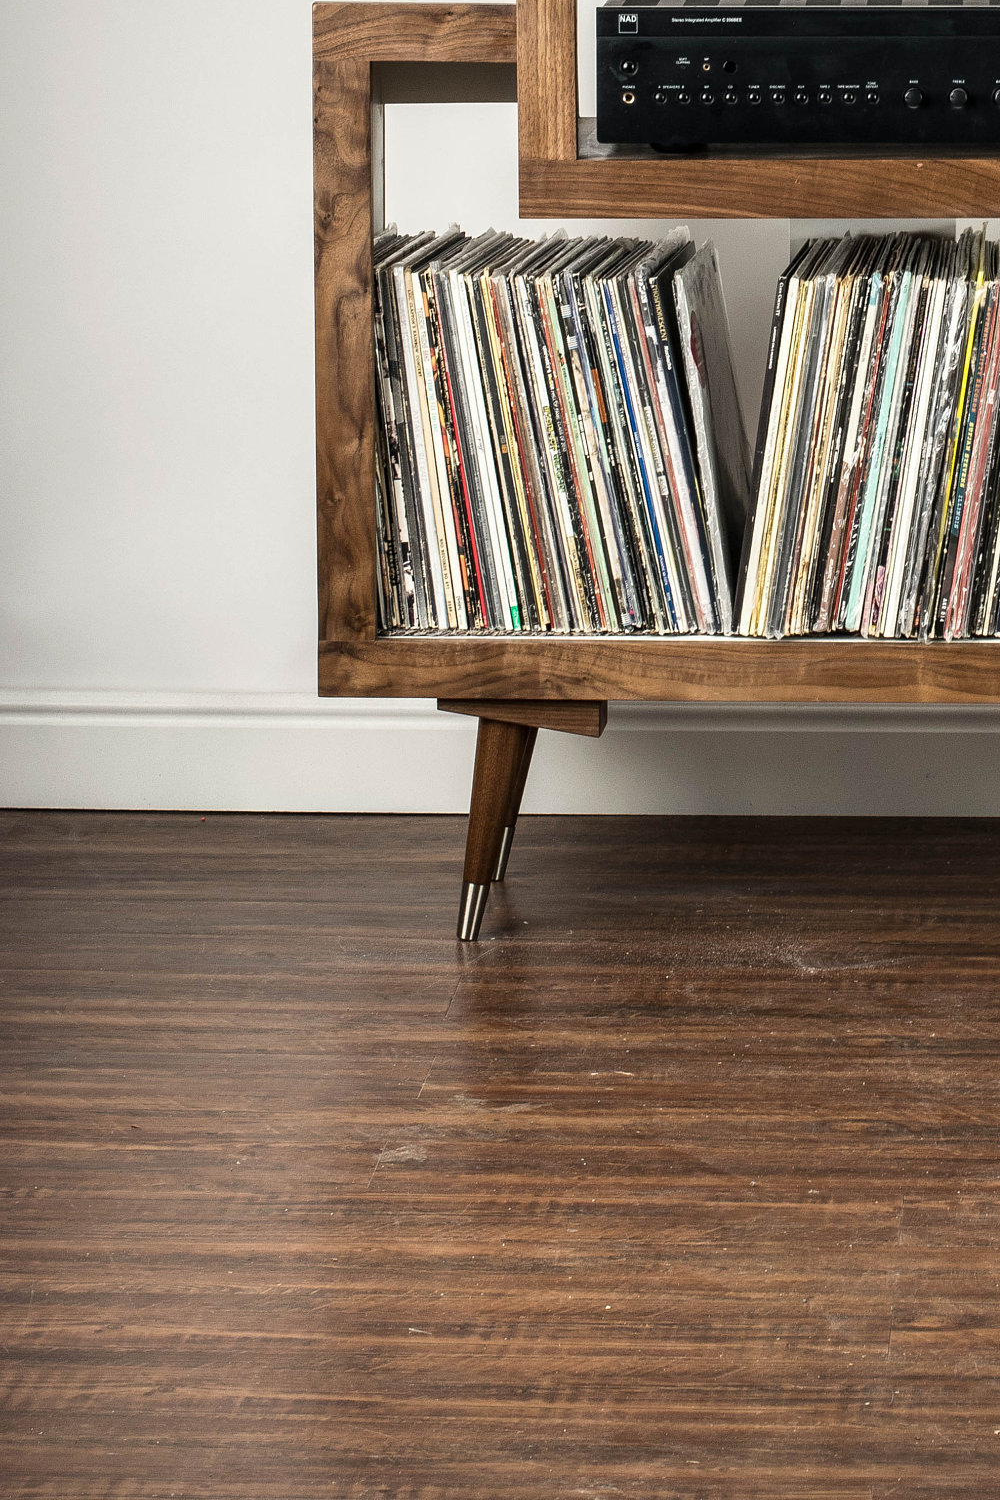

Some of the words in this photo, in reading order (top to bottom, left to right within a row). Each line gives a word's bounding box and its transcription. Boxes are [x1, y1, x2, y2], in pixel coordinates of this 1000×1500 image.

[652, 284, 668, 342] PHOSPHORESCENT
[970, 378, 980, 412] RECORDS
[965, 421, 974, 451] SUFJAN
[959, 452, 970, 488] STEVENS
[953, 494, 963, 529] ILLINOIS
